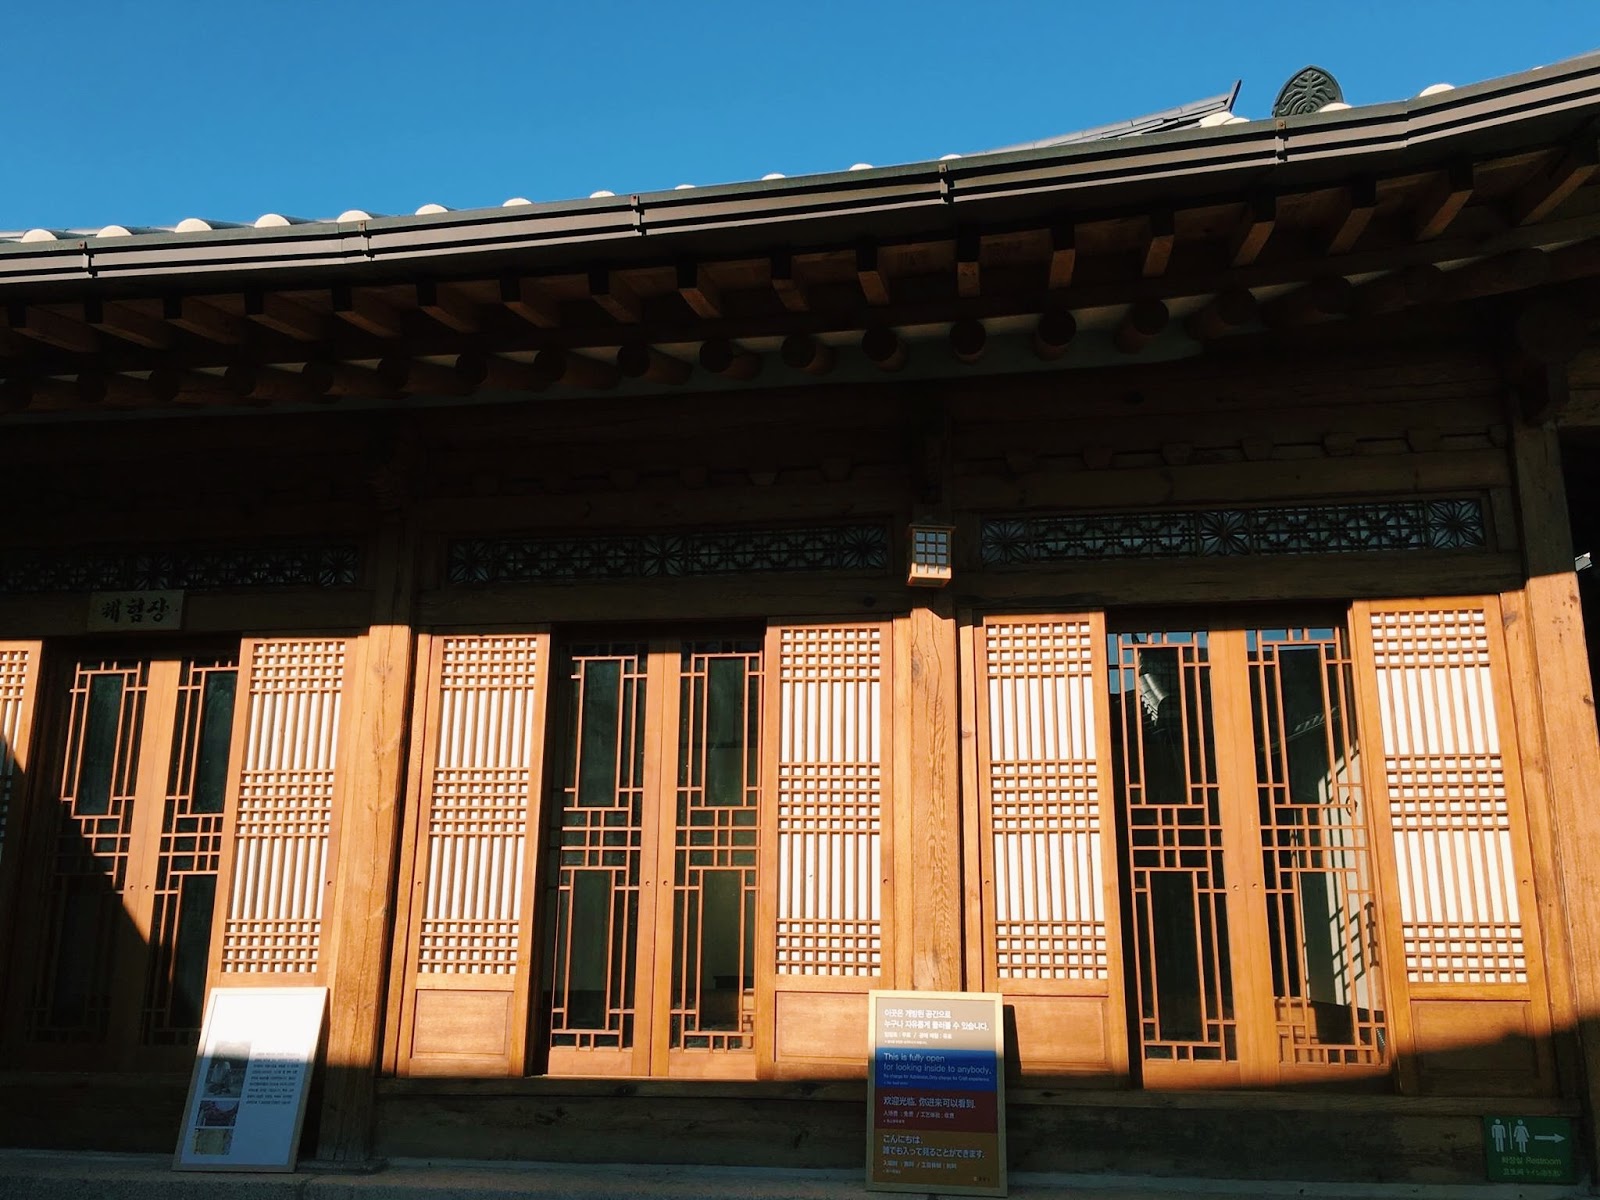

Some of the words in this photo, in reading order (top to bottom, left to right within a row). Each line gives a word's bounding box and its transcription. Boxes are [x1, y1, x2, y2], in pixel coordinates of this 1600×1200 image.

[102, 597, 169, 622] 체험장
[884, 1009, 903, 1017] 이곳은
[925, 1010, 951, 1018] 공간으로
[884, 1019, 904, 1028] 누구나
[905, 1020, 930, 1029] 자유롭게
[953, 1021, 960, 1030] 수
[961, 1022, 989, 1031] 있습니다.
[884, 1052, 899, 1060] This
[901, 1053, 907, 1061] is
[909, 1053, 924, 1062] fully
[896, 1064, 922, 1072] looking
[924, 1064, 946, 1072] inside
[957, 1066, 992, 1074] anybody.
[1526, 1157, 1561, 1166] Restroom
